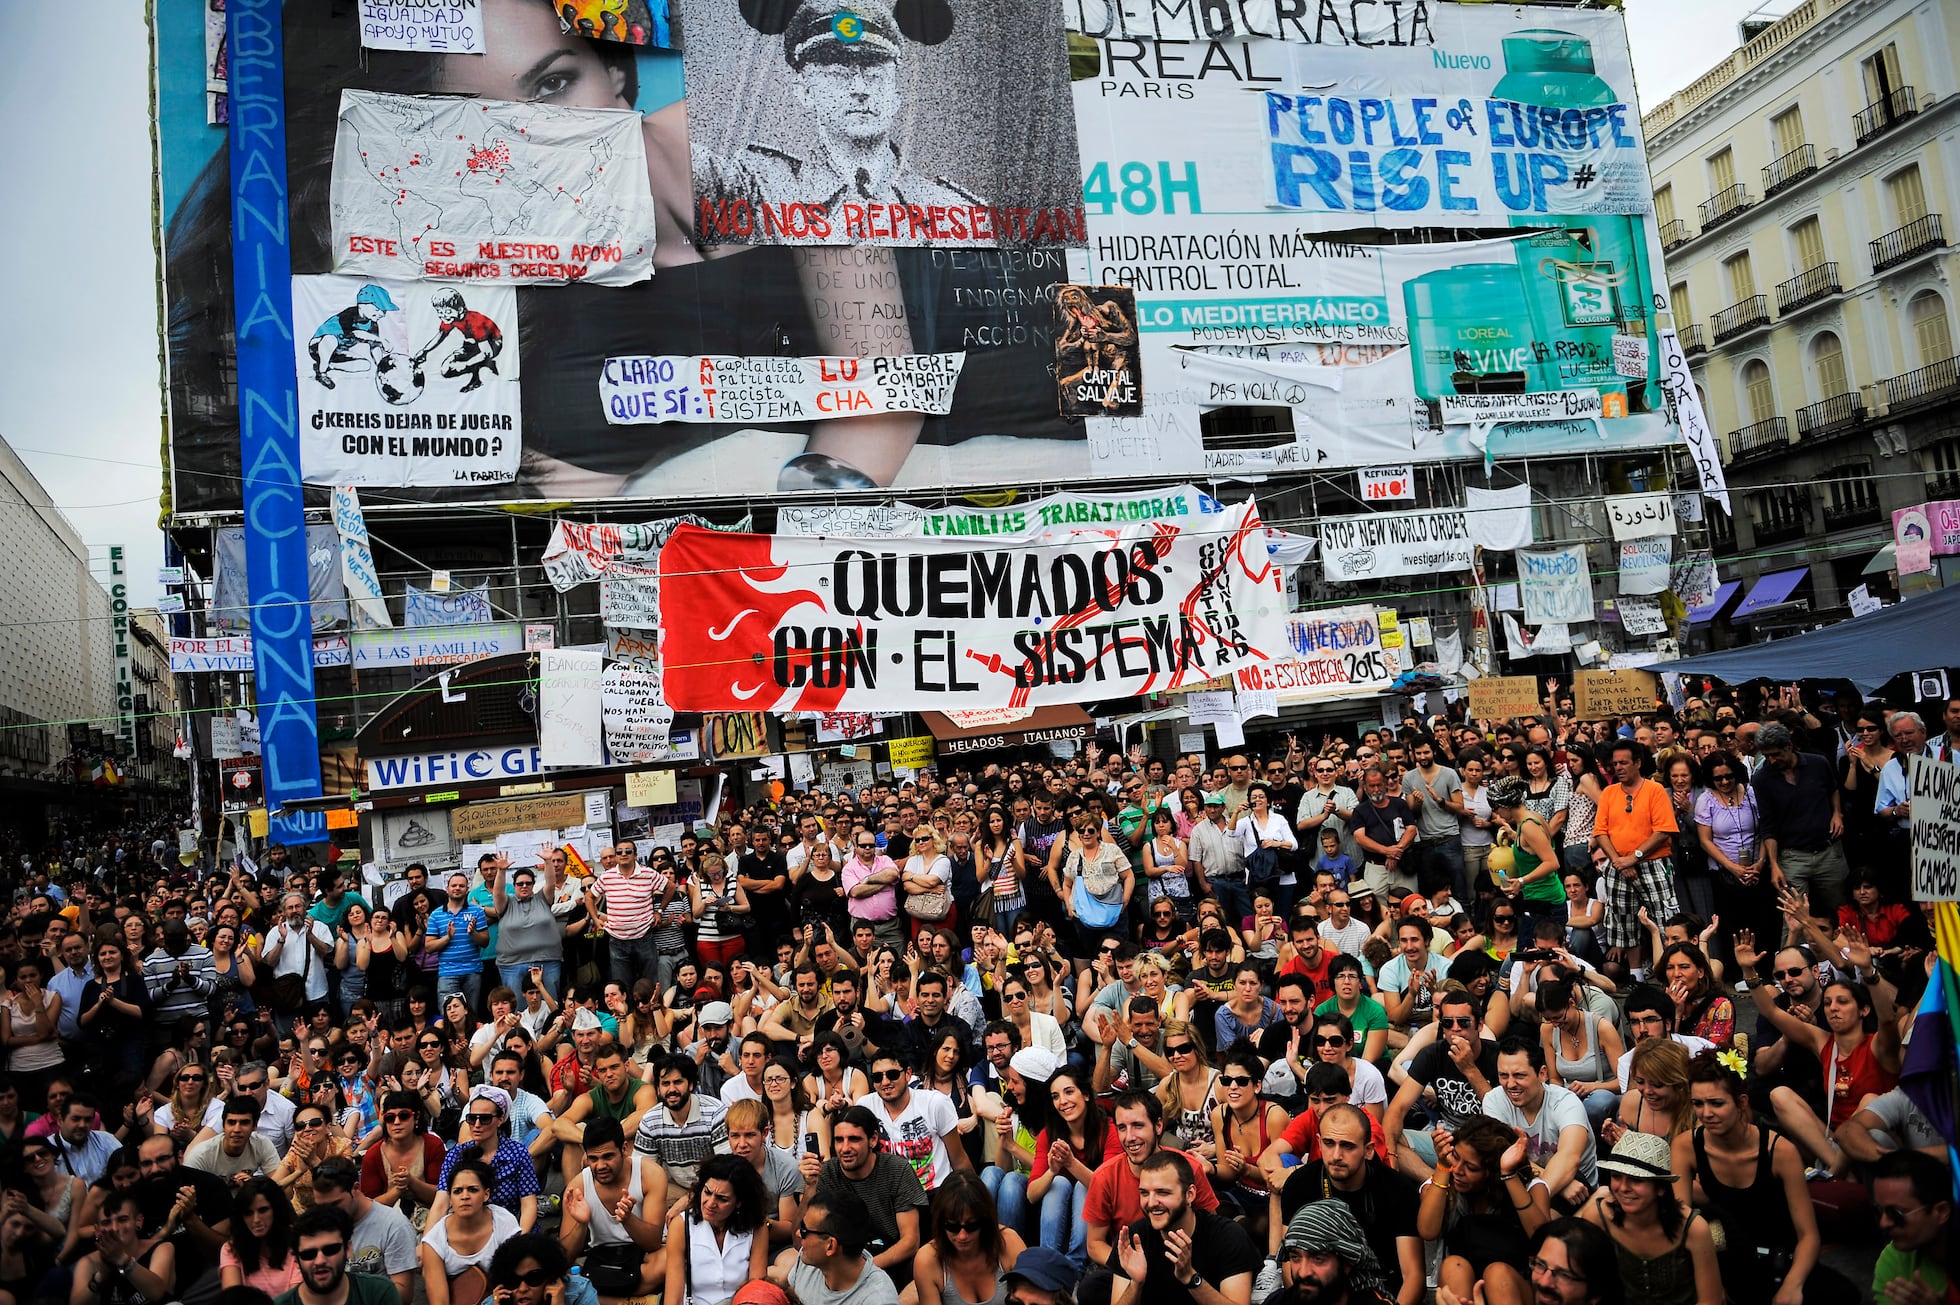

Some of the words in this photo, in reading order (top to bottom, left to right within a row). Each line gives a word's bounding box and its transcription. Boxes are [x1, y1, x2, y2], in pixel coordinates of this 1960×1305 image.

[363, 5, 464, 23] IGUALDAD
[1079, 0, 1435, 47] DEMOCRACIA
[1104, 39, 1283, 81] REAL
[1433, 49, 1491, 70] Nuevo
[1268, 91, 1443, 147] PEOPLE
[1446, 98, 1477, 137] of
[1486, 99, 1637, 150] EUROPE
[1083, 160, 1201, 215] 48H
[1491, 152, 1568, 212] UP
[700, 199, 753, 238] NO
[762, 202, 832, 239] NOS
[844, 203, 1086, 242] REPRESENTAN
[350, 236, 397, 257] ESTE
[430, 241, 455, 257] ES
[479, 242, 559, 261] NUESTRO
[1098, 229, 1266, 262] HIDRATACIÓN
[425, 263, 500, 278] SEGUIMOS
[510, 263, 587, 279] CRECIENDO
[1102, 264, 1217, 292] CONTROL
[1220, 263, 1301, 290] TOTAL.
[1183, 298, 1380, 326] MEDITERRÁNEO
[1292, 321, 1353, 341] GRACIAS
[604, 359, 674, 387] CLARO
[718, 373, 804, 388] patriarcal
[819, 358, 858, 382] LU
[720, 386, 785, 401] racista
[816, 389, 873, 413] CHA
[1077, 385, 1137, 404] SALVAJE
[1210, 382, 1236, 400] DAS
[1243, 380, 1281, 400] VOLK
[610, 391, 657, 419] QUE
[720, 401, 804, 419] SISTEMA
[1663, 333, 1692, 405] TODA
[1688, 428, 1718, 488] VIDA
[311, 409, 381, 430] ¿KEREIS
[385, 413, 432, 430] DEJAR
[437, 413, 457, 430] DE
[460, 413, 512, 431] JUGAR
[342, 434, 384, 456] CON
[388, 436, 407, 457] EL
[1204, 450, 1245, 468] MADRID
[782, 508, 804, 523] NO
[1038, 494, 1188, 527] TRABAJADORAS
[801, 521, 815, 533] EL
[822, 520, 875, 533] SISTEMA
[879, 520, 894, 531] ES
[1324, 521, 1355, 551] STOP
[1359, 518, 1387, 547] NEW
[1389, 516, 1428, 545] WORLD
[1430, 513, 1470, 542] ORDER
[111, 546, 123, 575] EL
[245, 388, 317, 792] NACIONAL
[834, 541, 1161, 617] QUEMADOS
[112, 584, 128, 658] CORTE
[172, 641, 207, 655] POR
[216, 641, 236, 654] EL
[355, 651, 367, 662] A
[378, 645, 410, 660] LAS
[419, 640, 500, 657] FAMILIAS
[773, 625, 877, 690] CON
[914, 629, 980, 692] EL
[1014, 612, 1203, 688] SISTEMA
[171, 657, 195, 671] LA
[547, 656, 599, 672] BANCOS
[612, 663, 630, 672] CON
[1238, 664, 1263, 691] NO
[1275, 657, 1350, 690] ESTRATEGIA
[1344, 651, 1389, 684] 2015
[604, 687, 650, 697] CALLABAN
[1617, 696, 1649, 705] GENTE
[604, 707, 623, 716] NOS
[625, 707, 646, 715] HAN
[611, 741, 622, 749] DE
[624, 740, 635, 748] LA
[615, 732, 632, 741] HAN
[635, 733, 665, 742] HECHO
[949, 736, 1005, 752] HELADOS
[1023, 727, 1087, 744] ITALIANOS
[614, 750, 630, 759] UN
[672, 751, 694, 759] GOWEX
[1914, 760, 1931, 797] LA
[515, 802, 533, 813] NOS
[457, 824, 477, 834] UNA
